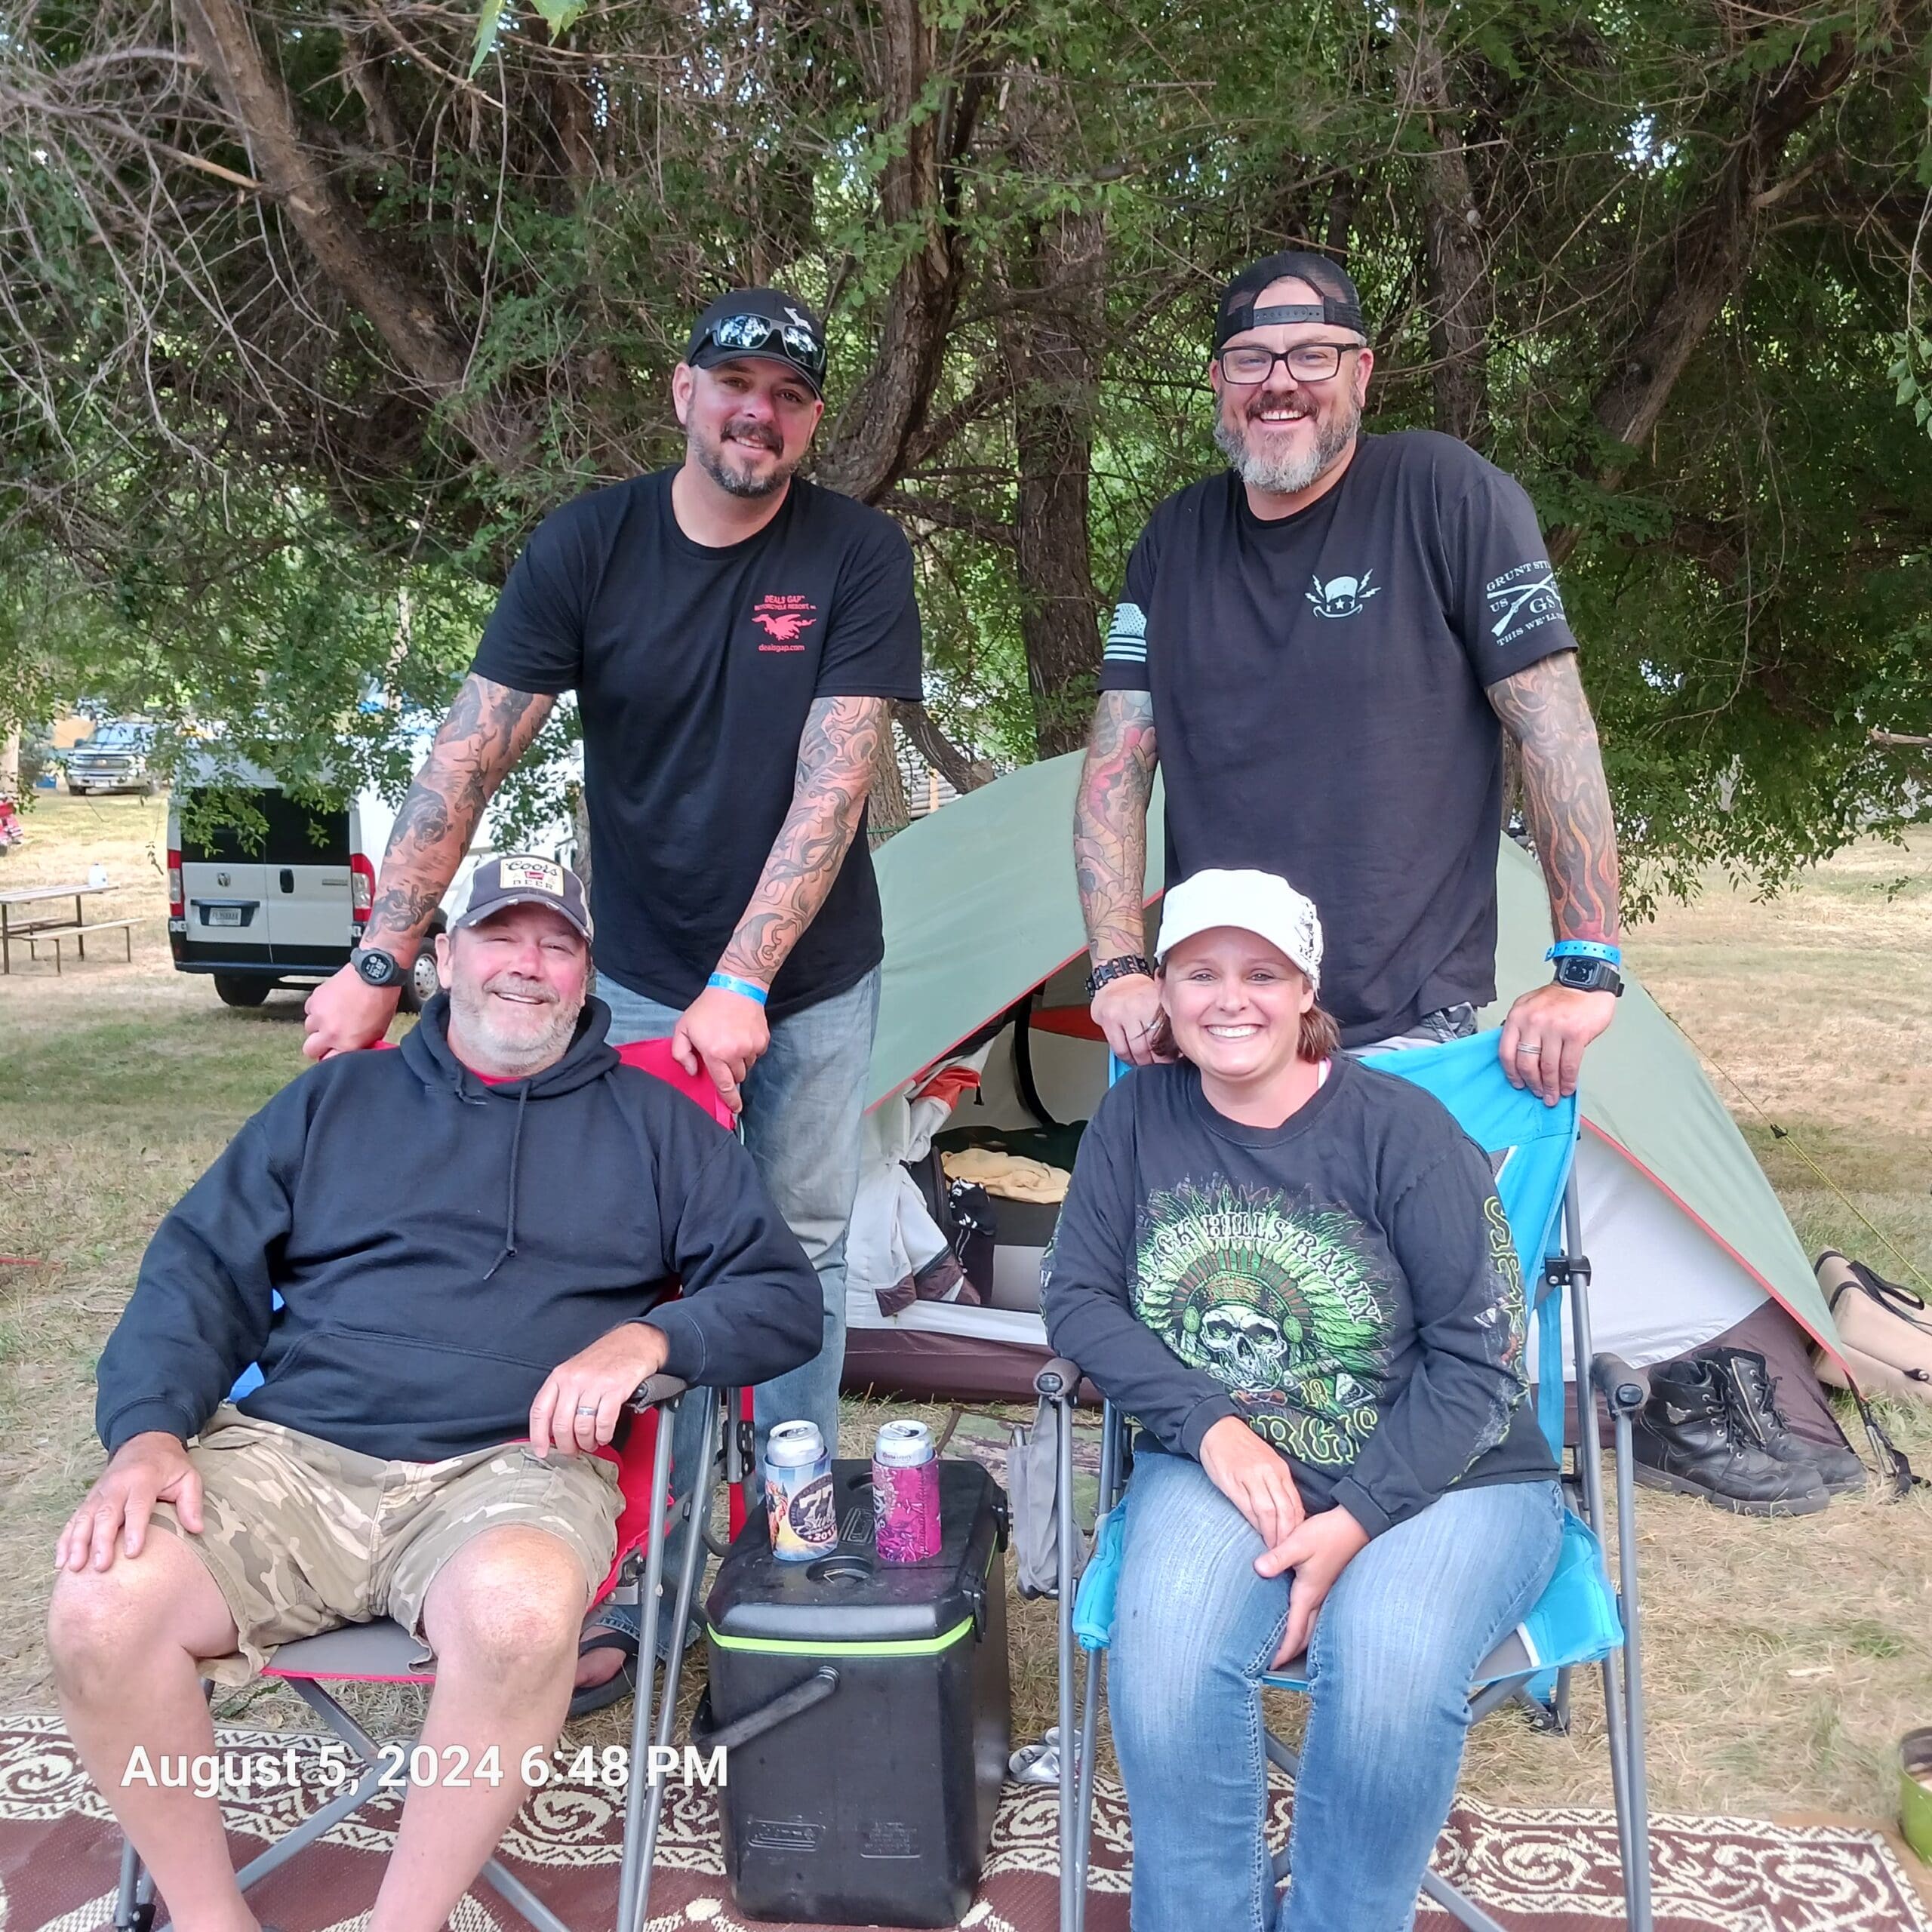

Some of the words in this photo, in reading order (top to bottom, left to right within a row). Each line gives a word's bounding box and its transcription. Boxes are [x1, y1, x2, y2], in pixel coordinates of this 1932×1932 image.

[1487, 563, 1531, 591] GRUNT
[764, 595, 786, 604] DEALS
[1490, 598, 1509, 612] US
[1529, 595, 1555, 614] GS
[1497, 628, 1524, 646] THIS
[1525, 613, 1557, 630] WE'LL
[758, 644, 805, 652] dealsgap.com
[506, 860, 558, 876] Coors
[513, 879, 553, 890] BEER
[1204, 1211, 1290, 1242] HILLS
[1291, 1232, 1383, 1322] RALLY
